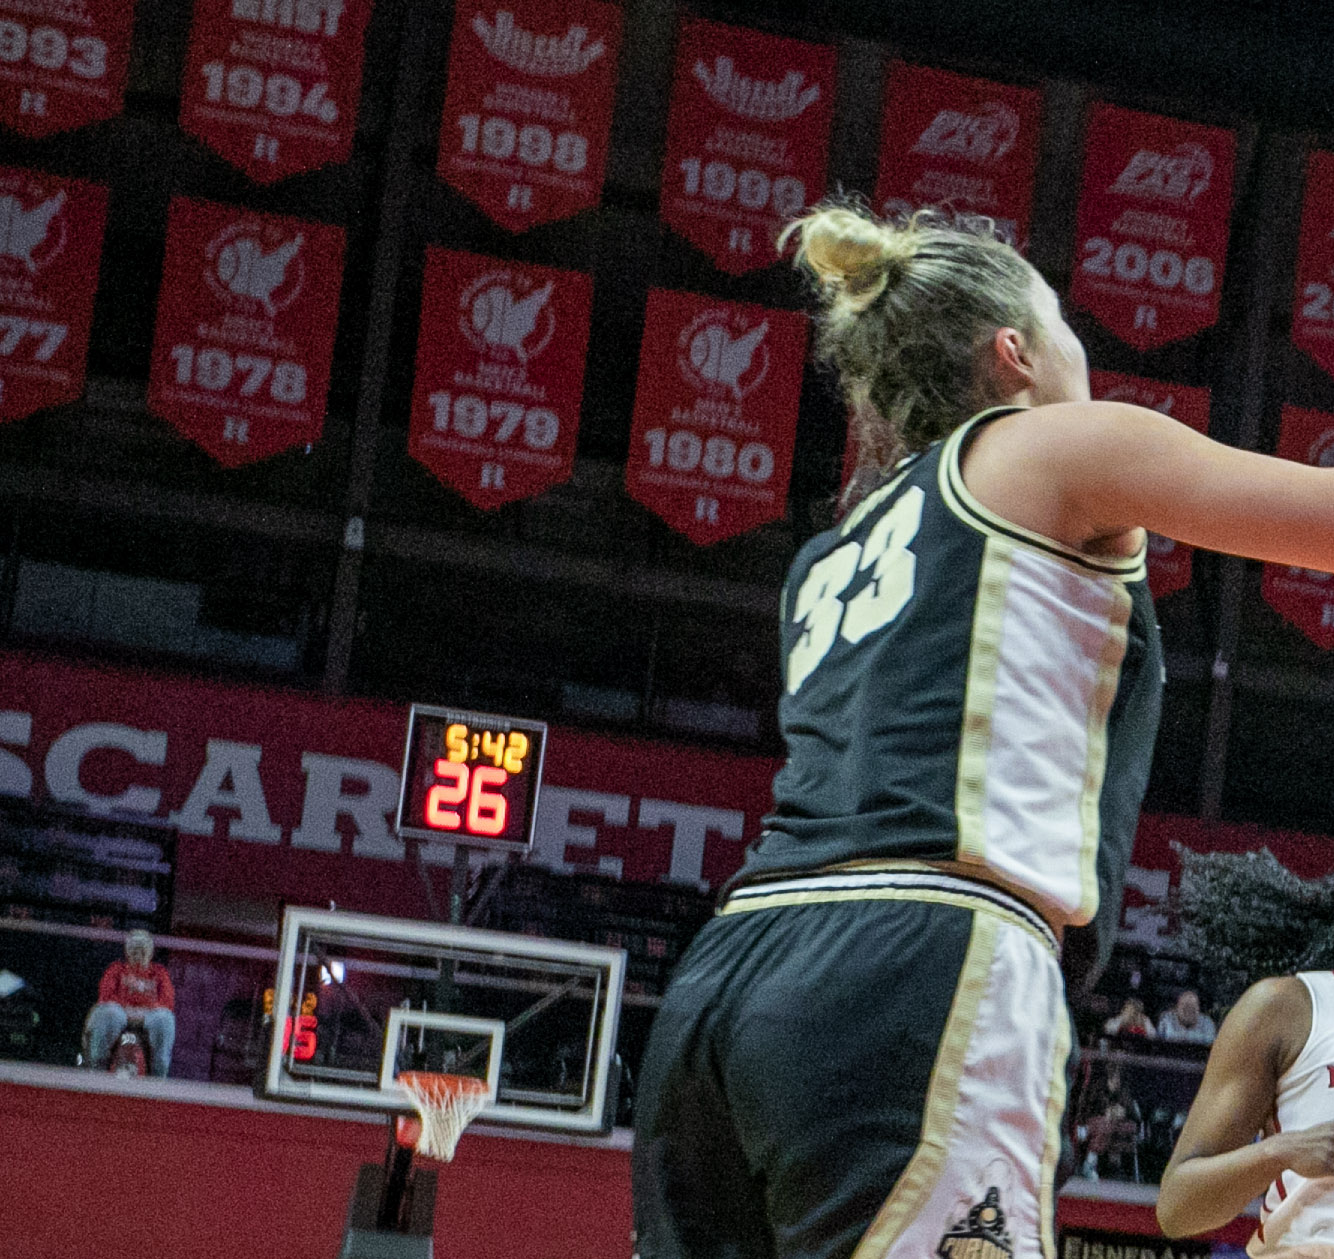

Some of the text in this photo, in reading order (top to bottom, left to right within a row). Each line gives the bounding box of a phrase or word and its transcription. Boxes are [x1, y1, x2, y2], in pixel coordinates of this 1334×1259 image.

[0, 20, 109, 79] 993
[200, 60, 338, 125] 1994
[457, 113, 588, 174] 1998
[0, 314, 69, 362] 77
[171, 343, 307, 403] 1978
[427, 391, 561, 449] 1979
[644, 428, 775, 483] 1980
[786, 485, 926, 696] 33
[446, 723, 528, 774] 5:42
[0, 709, 746, 892] CARET
[425, 758, 508, 836] 26
